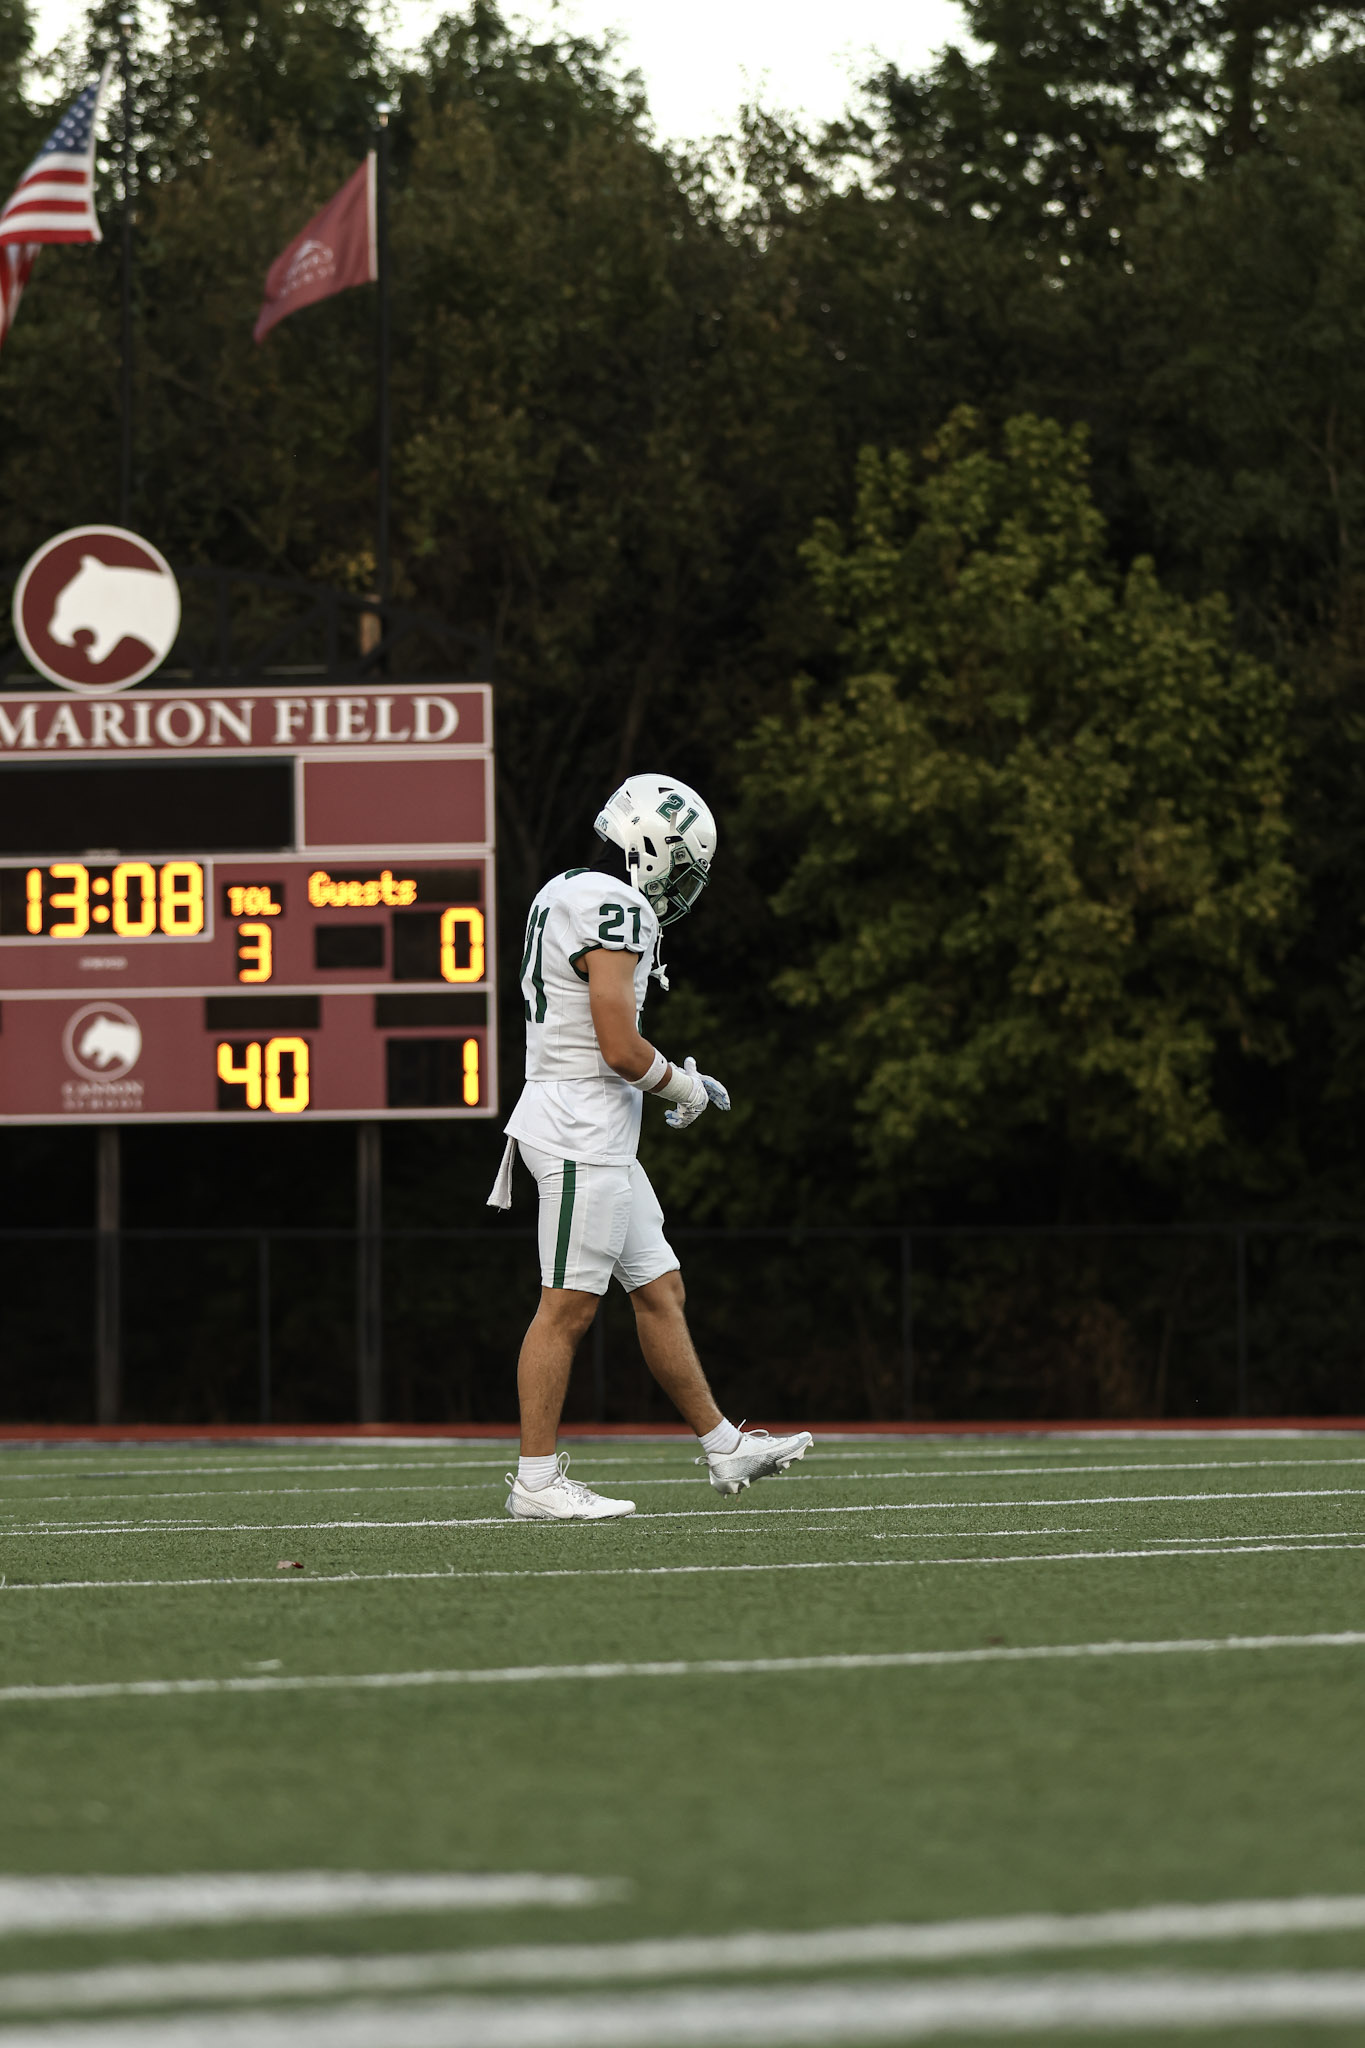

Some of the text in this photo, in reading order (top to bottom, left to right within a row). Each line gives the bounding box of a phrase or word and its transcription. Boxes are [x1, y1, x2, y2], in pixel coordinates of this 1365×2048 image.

[0, 696, 460, 748] MARION FIELD
[656, 793, 699, 835] 21
[26, 861, 204, 938] 13:08
[308, 870, 417, 907] Guests
[238, 922, 273, 982] 3
[440, 907, 485, 983] 0
[598, 903, 641, 944] 21
[217, 1037, 310, 1113] 40
[462, 1038, 480, 1106] 1
